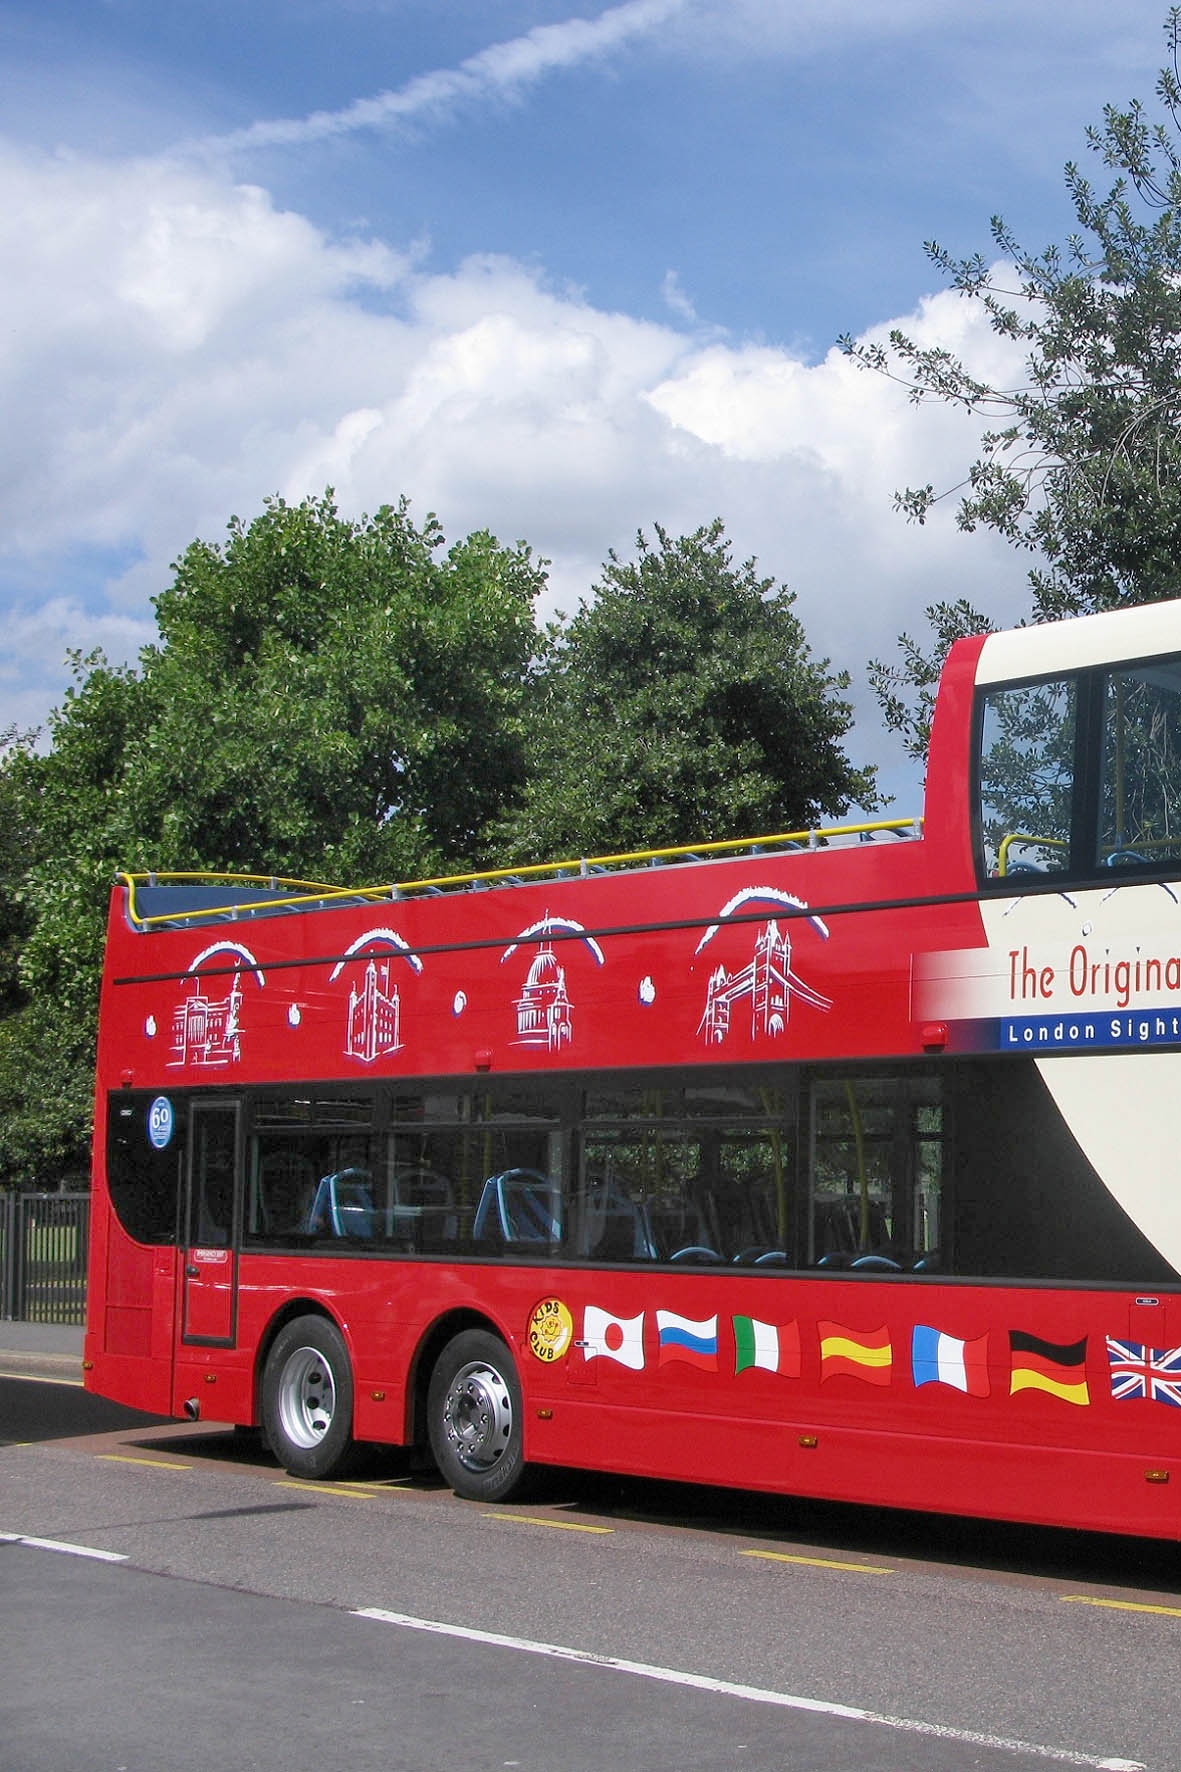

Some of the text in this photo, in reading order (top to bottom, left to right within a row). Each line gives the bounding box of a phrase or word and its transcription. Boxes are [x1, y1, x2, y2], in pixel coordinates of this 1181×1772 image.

[1008, 946, 1056, 1000] The
[1008, 1021, 1096, 1043] London
[152, 1107, 169, 1129] 60
[532, 1302, 560, 1326] KIDS
[529, 1331, 555, 1360] CLUB
